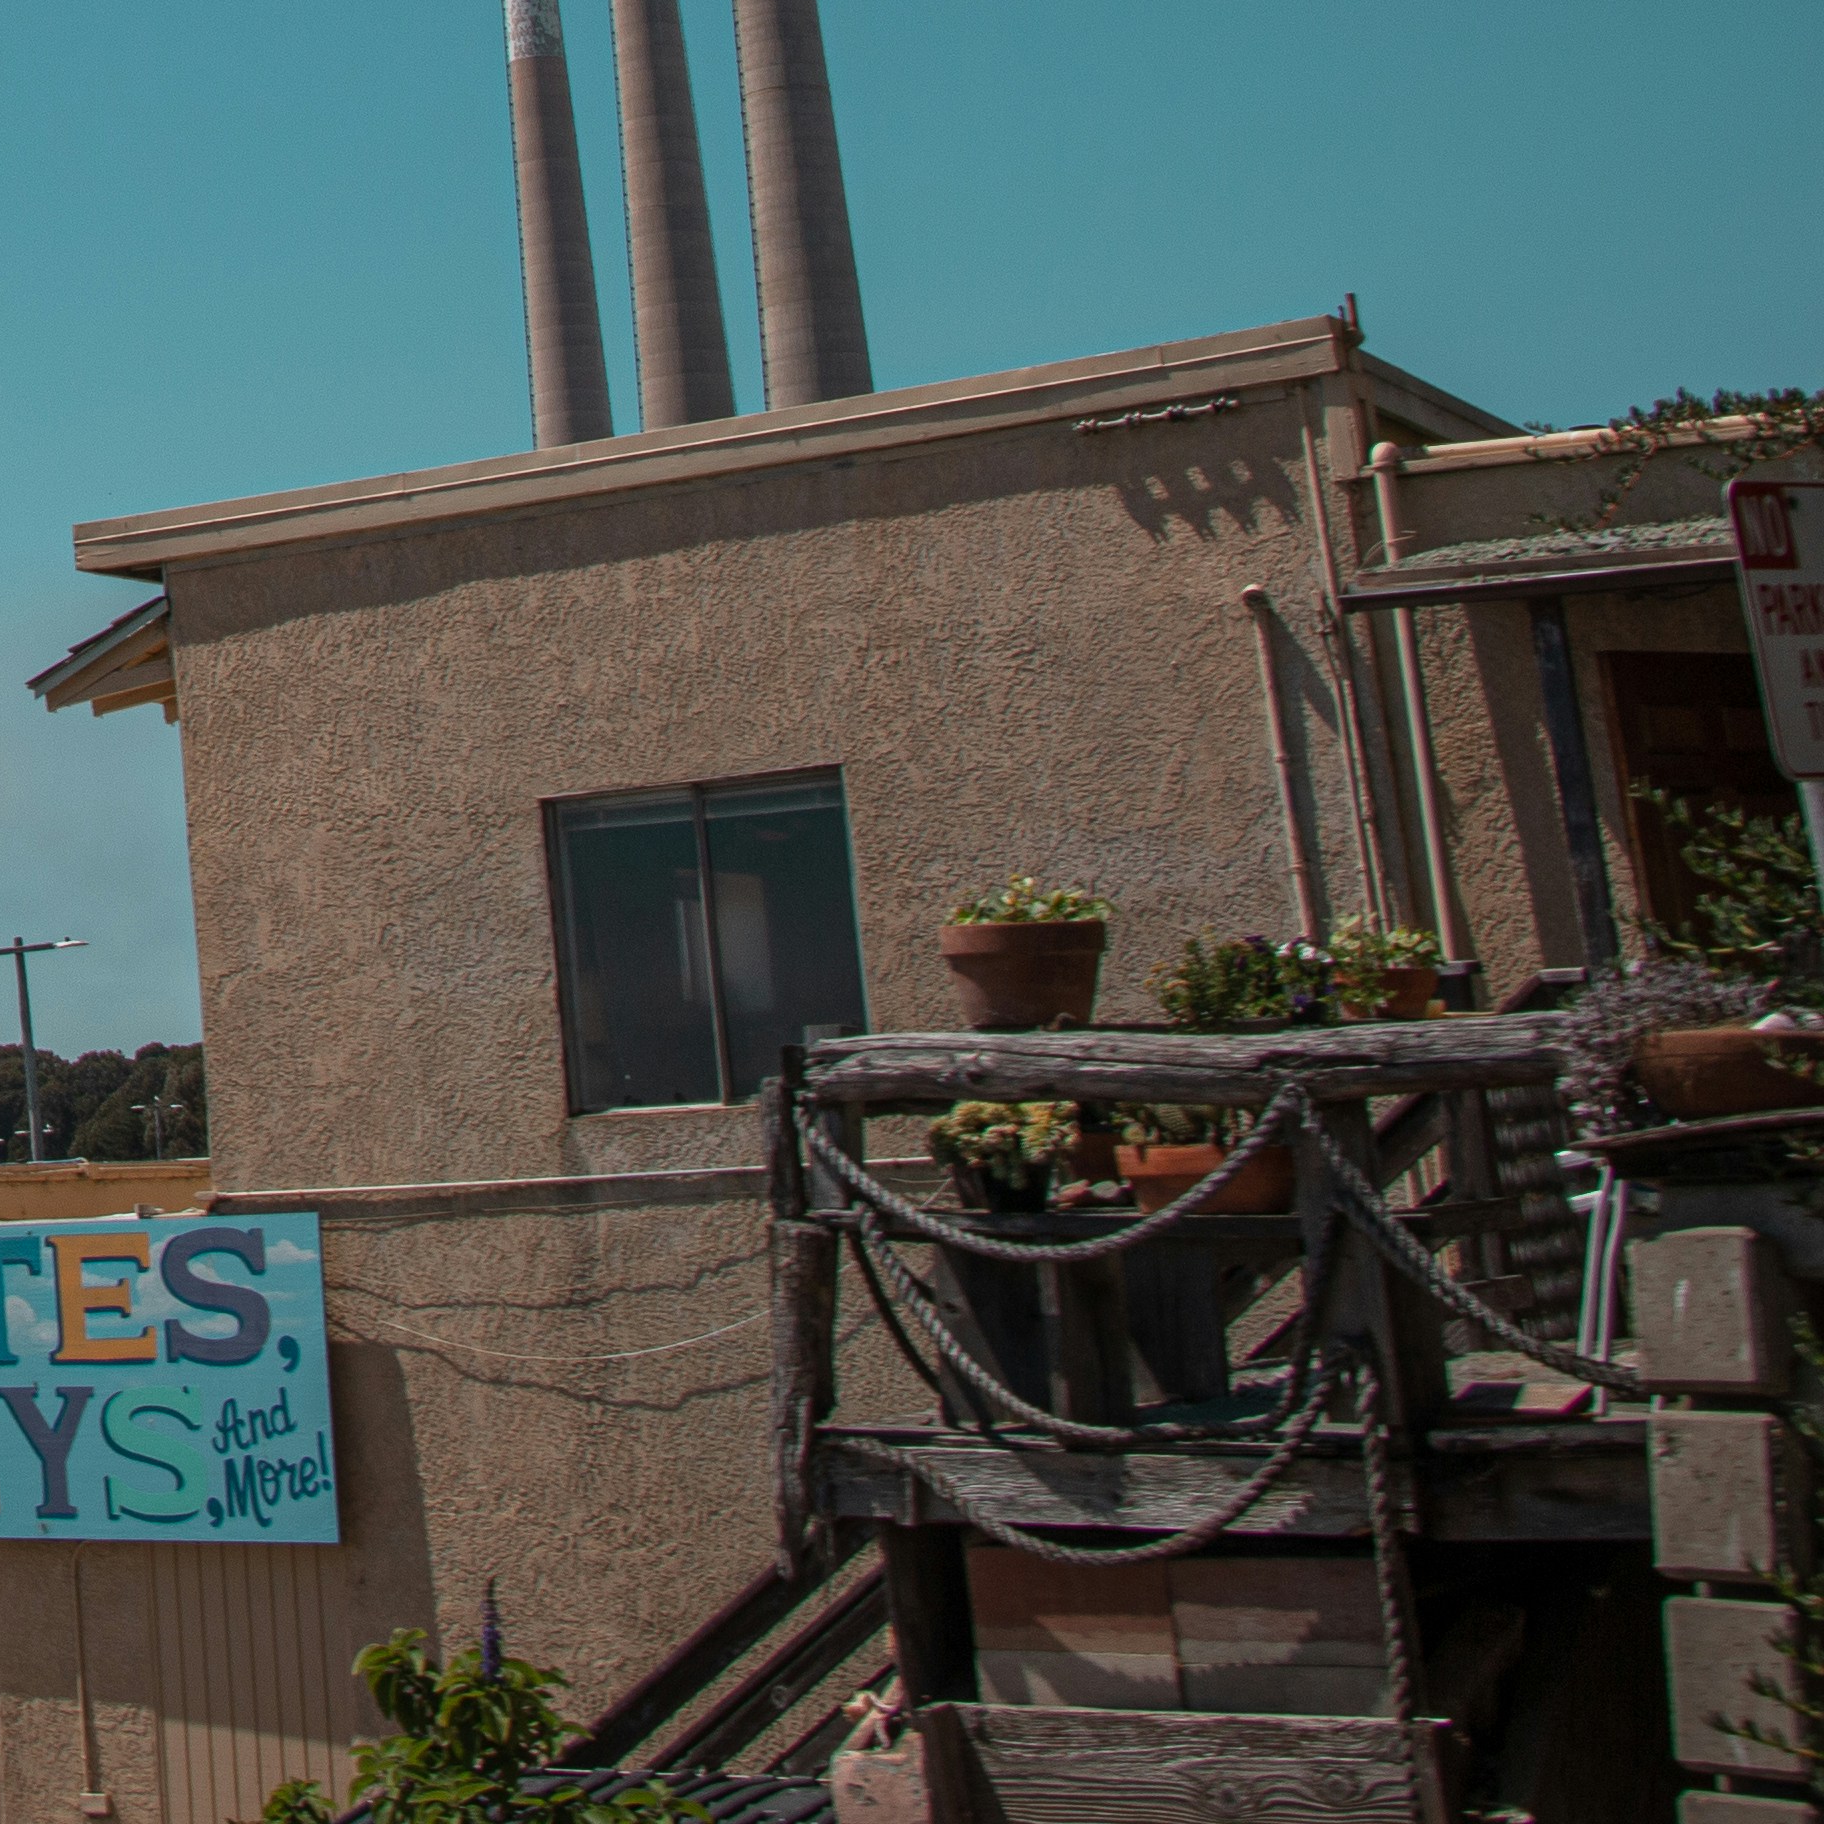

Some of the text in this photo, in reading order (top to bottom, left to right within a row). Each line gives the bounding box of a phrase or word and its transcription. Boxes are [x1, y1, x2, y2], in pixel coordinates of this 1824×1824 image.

[1737, 494, 1788, 557] NO
[212, 1387, 297, 1454] And
[223, 1431, 333, 1527] More!
